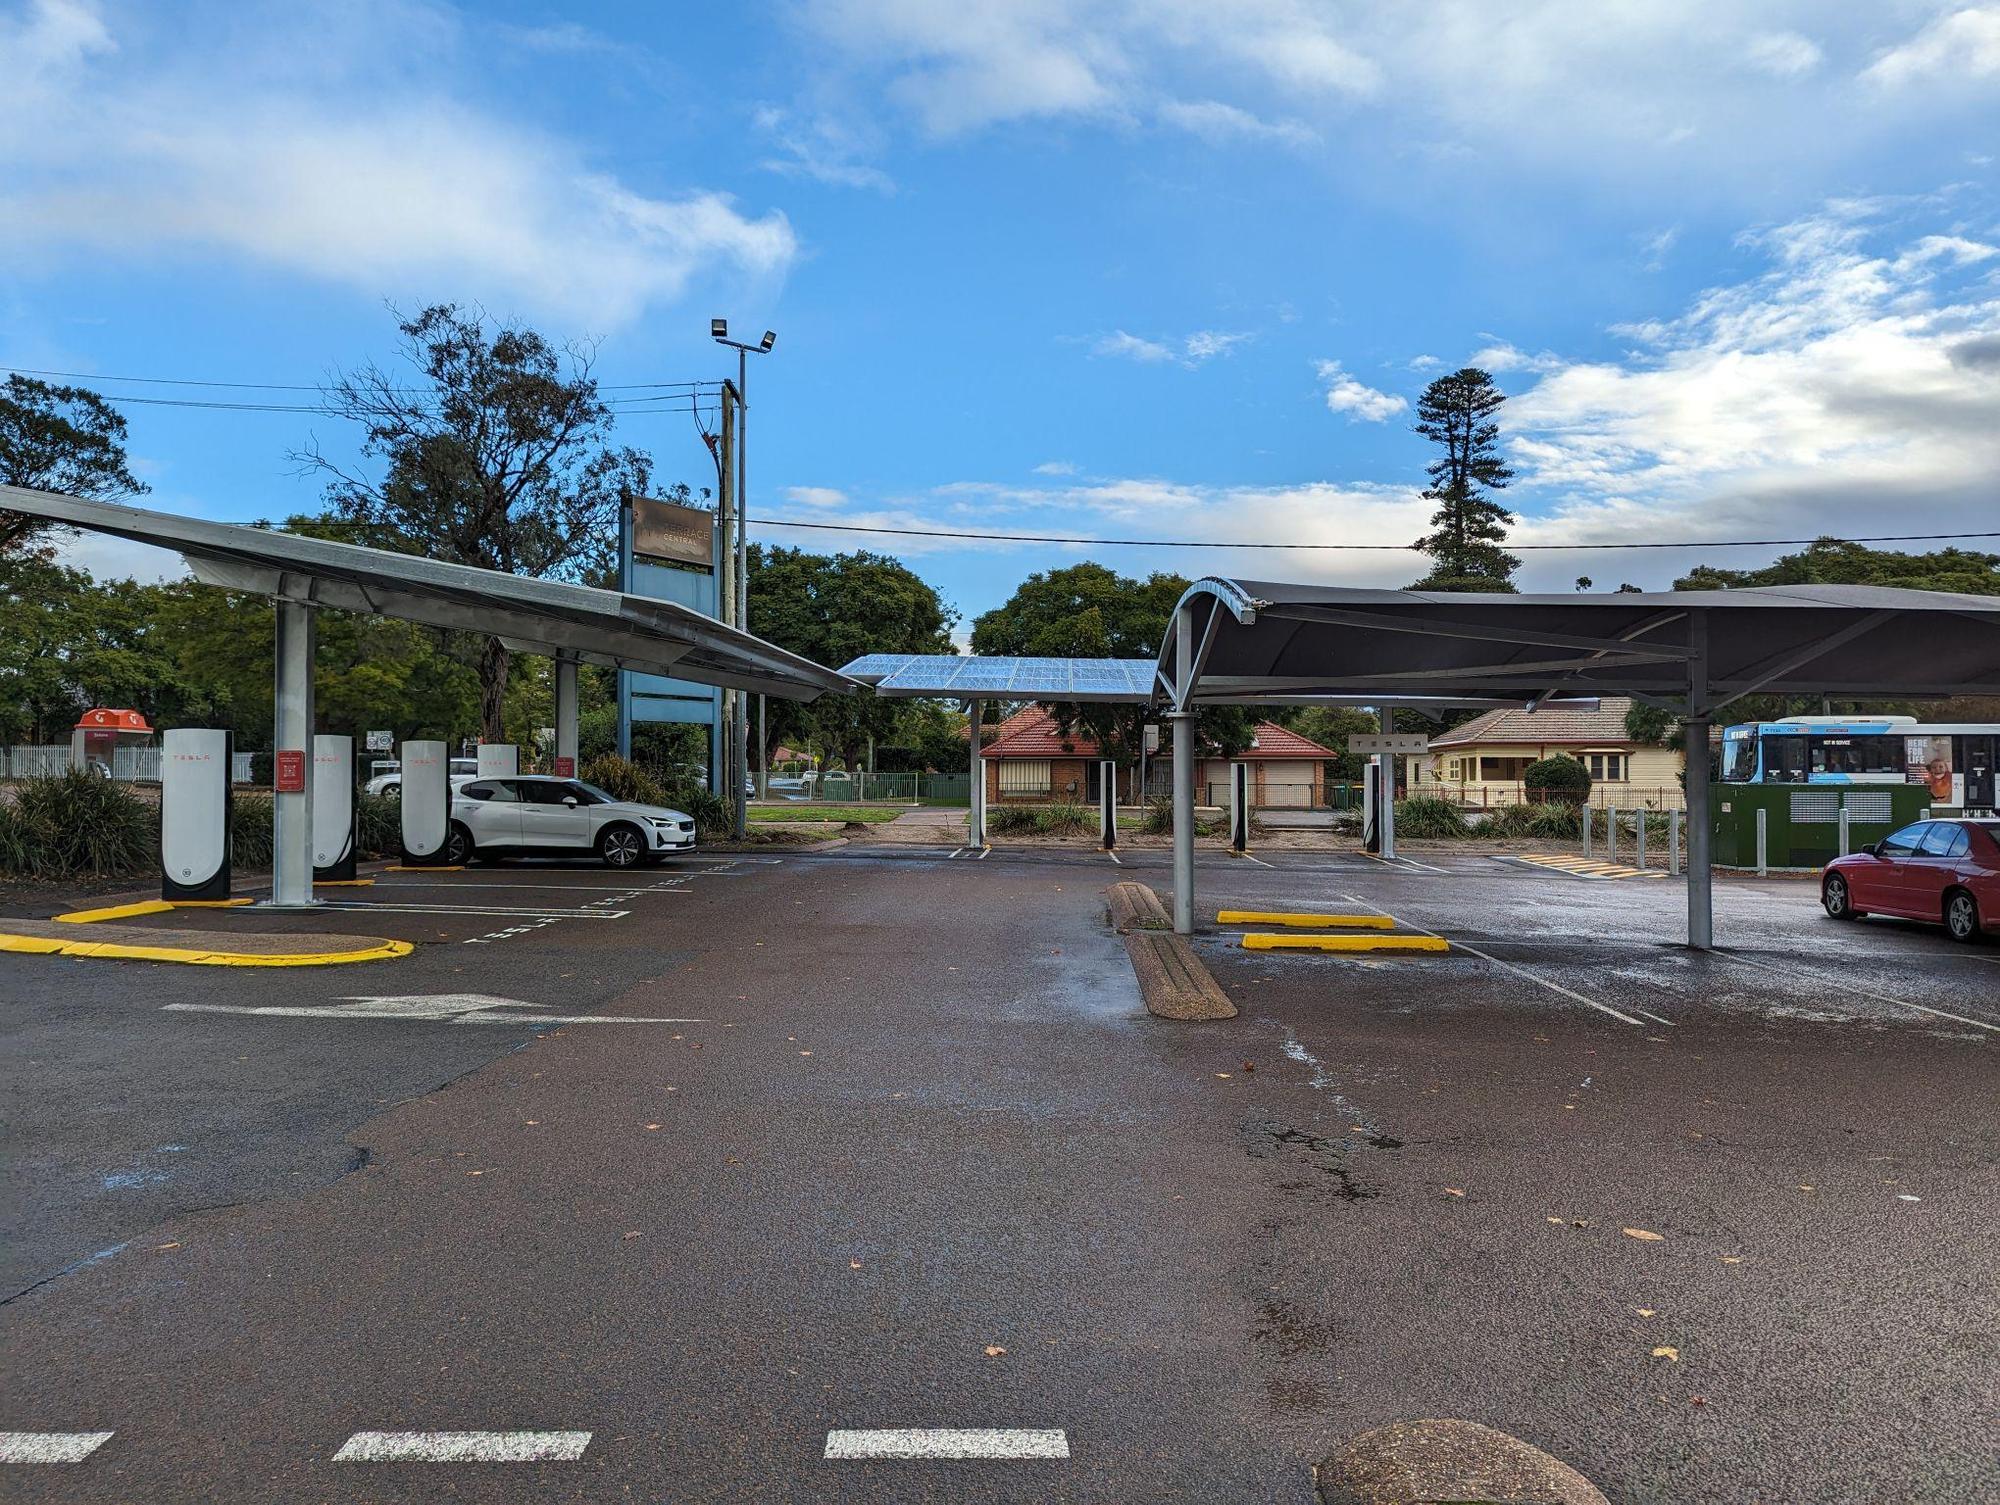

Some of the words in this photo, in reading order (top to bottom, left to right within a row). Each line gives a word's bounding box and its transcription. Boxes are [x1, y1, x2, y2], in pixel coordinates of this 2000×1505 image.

[664, 526, 710, 541] TERRACE
[663, 533, 697, 546] CENTRAL
[1907, 738, 1929, 748] HERE
[1907, 747, 1924, 756] FOR
[1907, 755, 1926, 764] LIFE
[463, 917, 562, 944] TESLA
